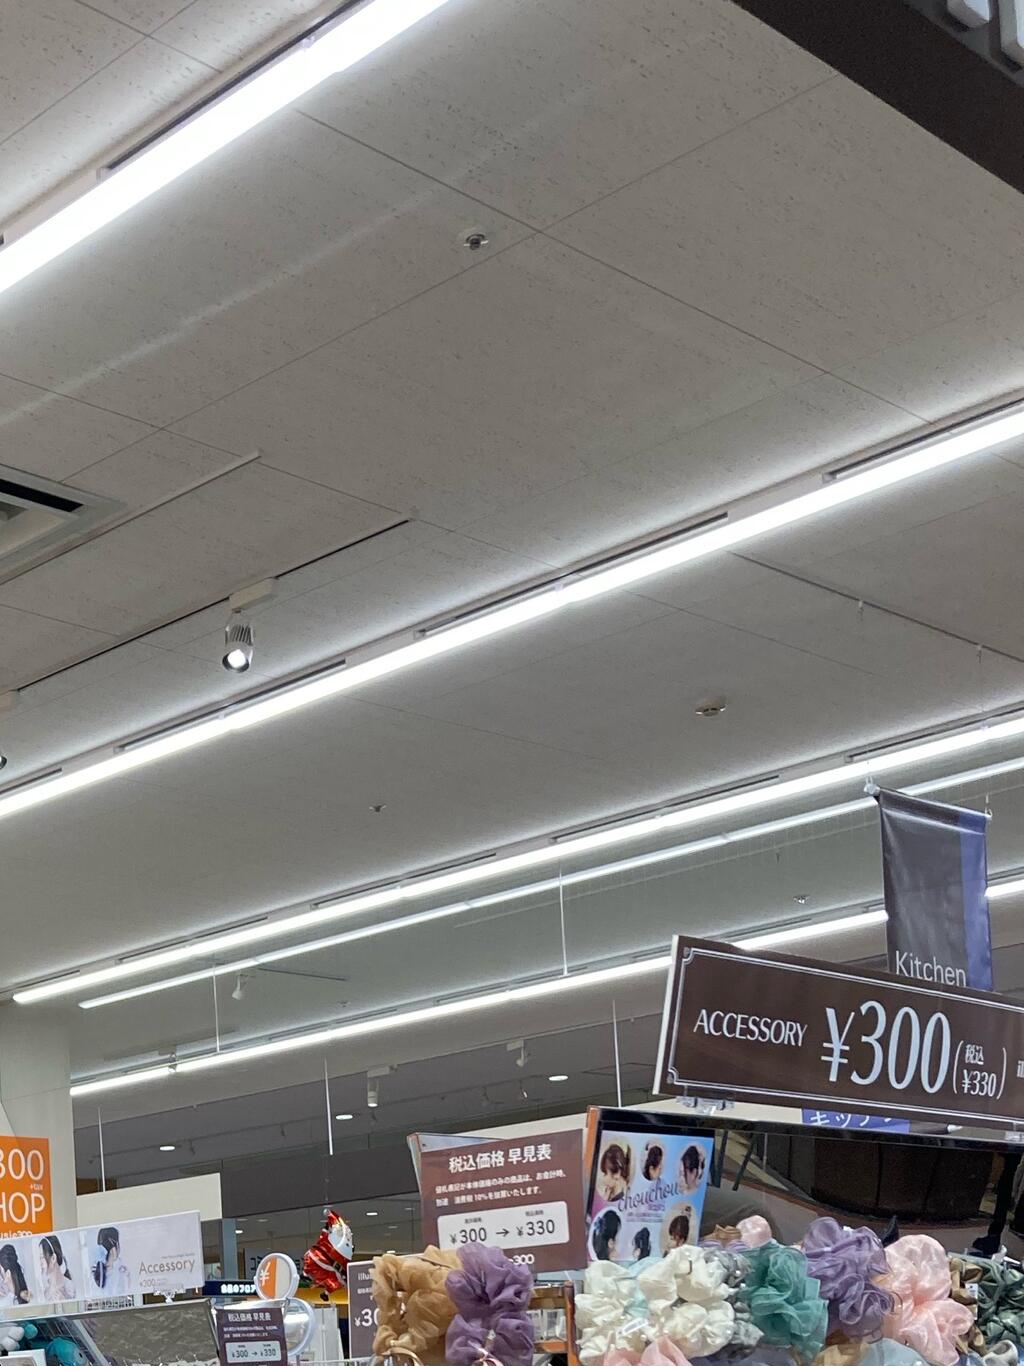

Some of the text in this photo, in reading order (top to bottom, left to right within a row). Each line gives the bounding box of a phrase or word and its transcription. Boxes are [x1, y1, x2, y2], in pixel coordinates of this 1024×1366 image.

[896, 950, 967, 987] Kitchen
[693, 1000, 951, 1094] ACCESSORY ¥300
[962, 1069, 996, 1097] ¥330
[450, 1219, 555, 1245] ¥300 ¥330
[139, 1259, 195, 1275] Accessory
